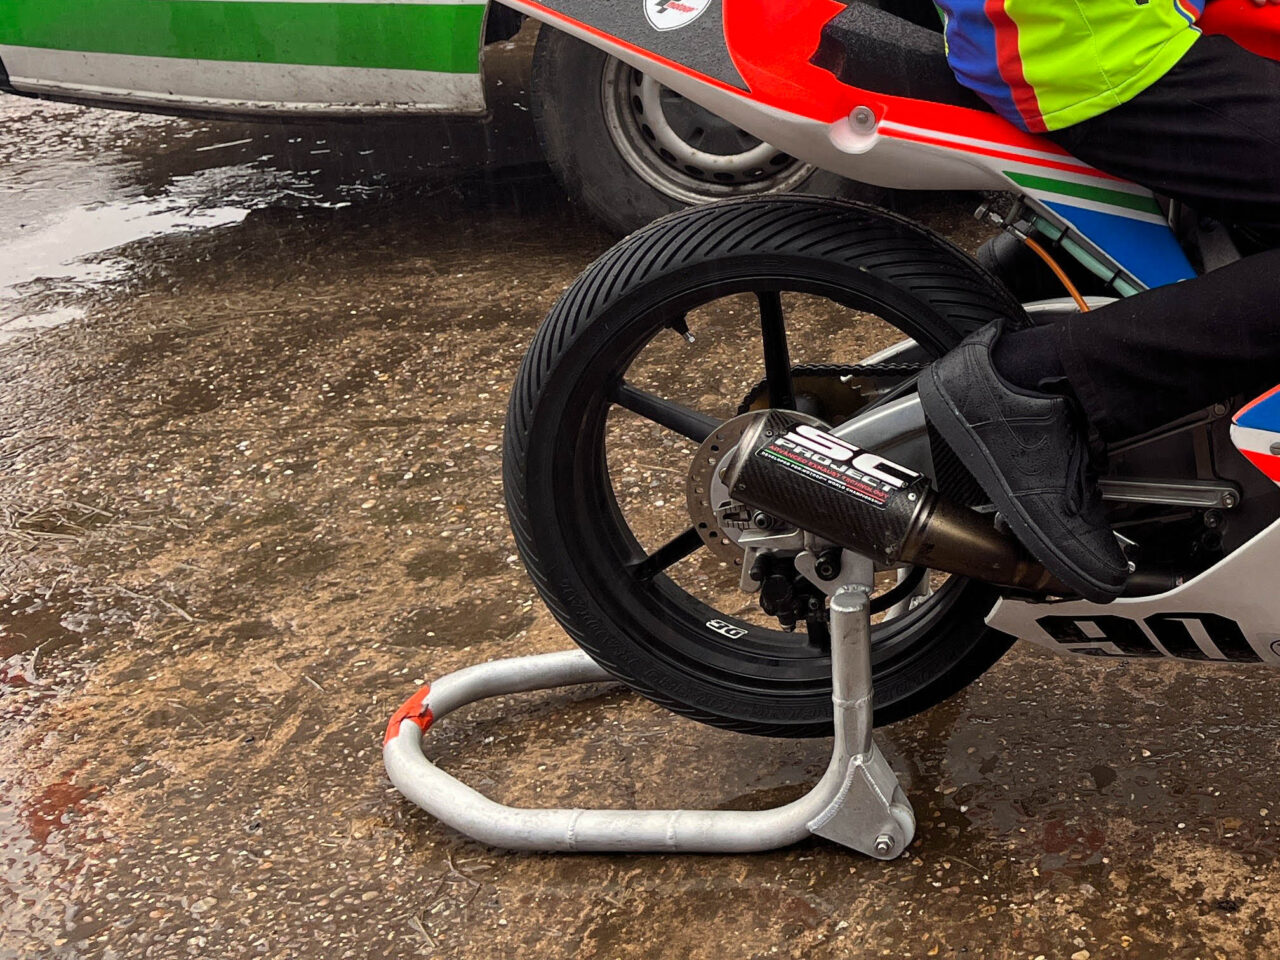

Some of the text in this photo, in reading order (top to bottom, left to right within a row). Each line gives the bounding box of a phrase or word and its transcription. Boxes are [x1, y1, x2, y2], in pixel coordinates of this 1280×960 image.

[769, 444, 890, 499] ADVANCED EXHAUST TECHNOLOGY
[774, 437, 897, 493] PROJECT
[784, 425, 920, 488] SC
